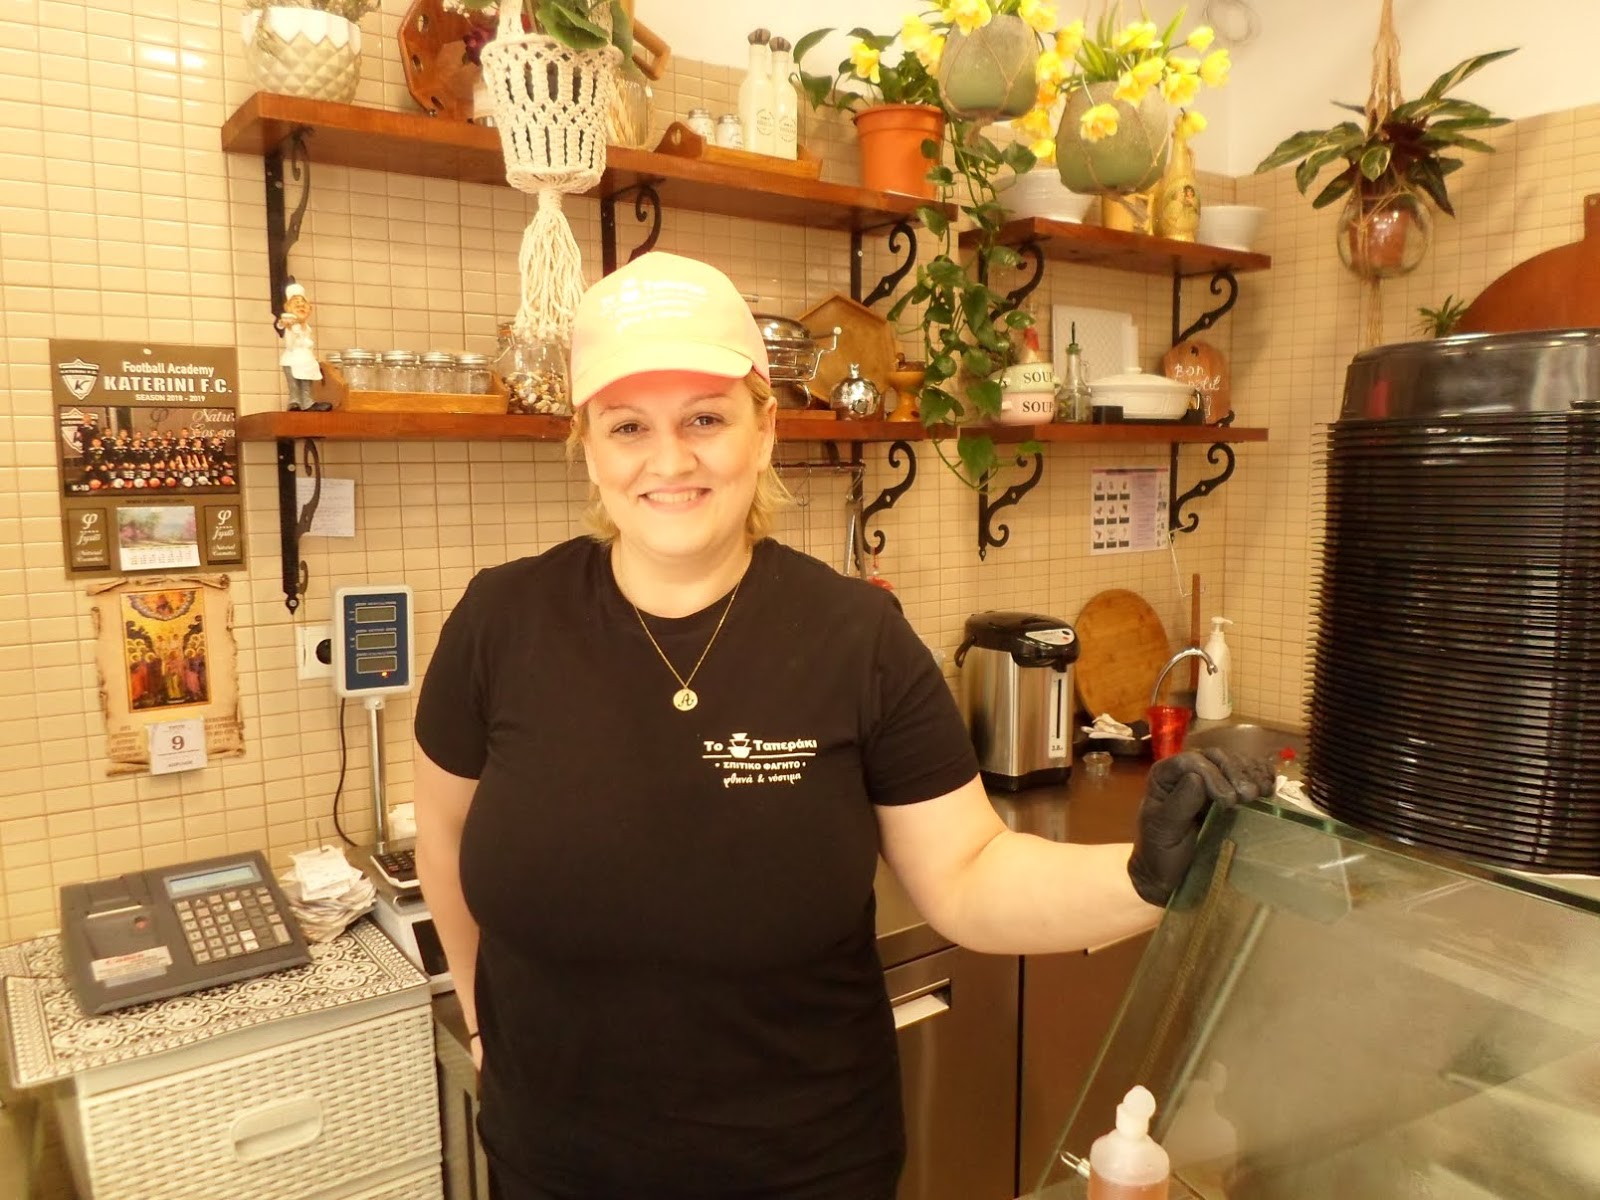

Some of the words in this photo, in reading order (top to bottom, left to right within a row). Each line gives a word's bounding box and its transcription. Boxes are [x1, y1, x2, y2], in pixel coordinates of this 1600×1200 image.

[122, 361, 165, 374] Football
[168, 363, 214, 377] Academy
[104, 375, 195, 392] KATERINI
[201, 378, 233, 393] F.C.
[135, 394, 166, 402] SEASON
[166, 394, 183, 402] 2018
[189, 395, 206, 403] 2019
[171, 735, 185, 751] 9
[703, 741, 724, 752] Το
[752, 738, 818, 752] Ταπεράκι
[723, 761, 762, 770] ΣΠΙΤΙΚΟ
[763, 760, 801, 770] ΦΑΓΗΤΟ
[723, 773, 753, 788] φθηνά
[757, 773, 765, 783] &
[768, 772, 802, 784] νόστιμα
